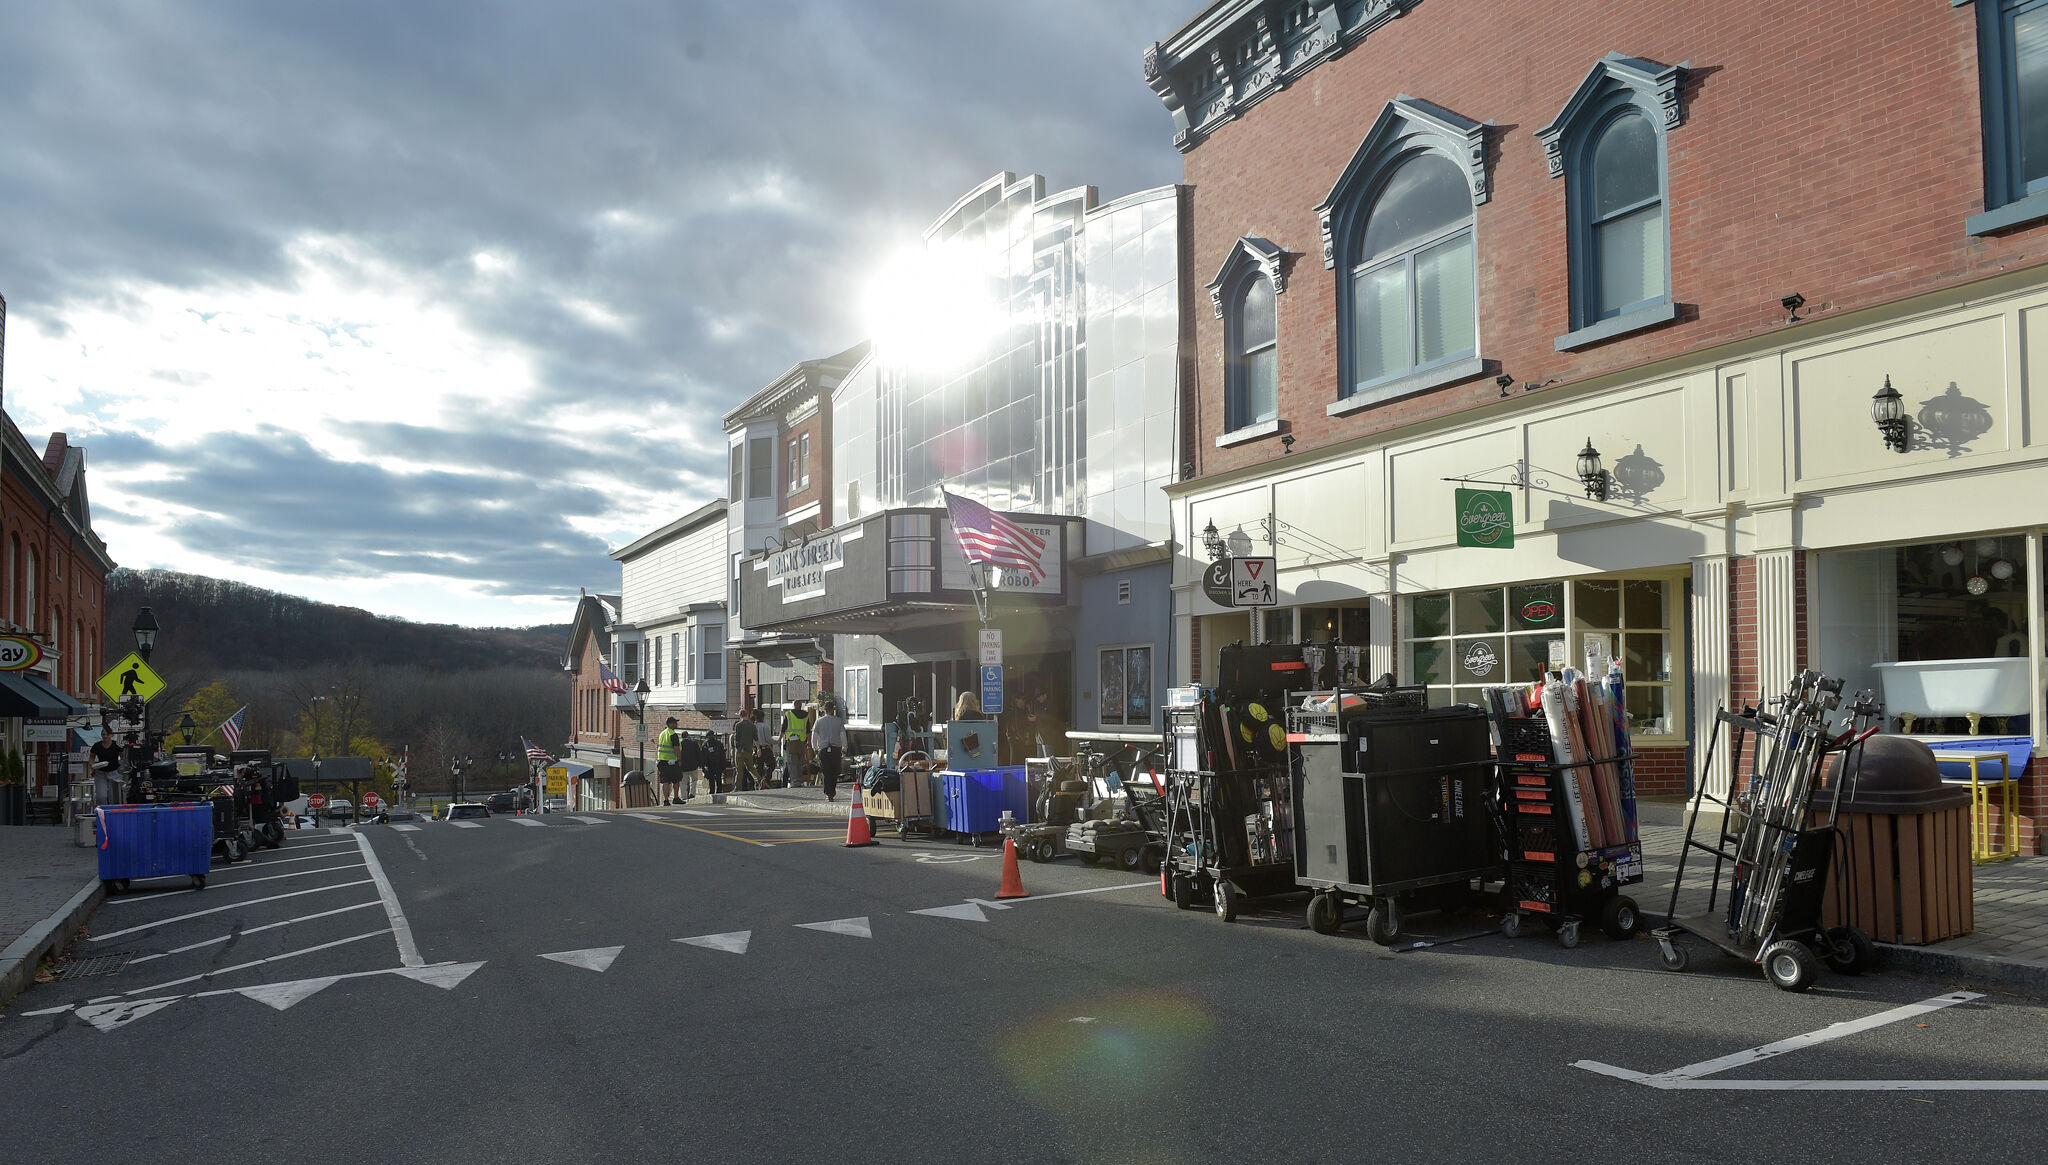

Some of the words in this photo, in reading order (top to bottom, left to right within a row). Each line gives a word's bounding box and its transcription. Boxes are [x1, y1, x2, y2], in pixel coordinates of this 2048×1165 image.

[1461, 510, 1506, 528] Evergreen
[774, 548, 799, 576] BANK
[799, 538, 834, 568] STREET
[786, 570, 822, 590] THEATER
[1521, 604, 1555, 618] OPEN
[981, 641, 1001, 649] PARKING
[1, 646, 24, 662] ay
[1464, 654, 1495, 665] Evergreen
[1554, 690, 1562, 705] LEE
[1564, 742, 1572, 754] LEE
[1454, 779, 1464, 818] CINELEASE
[1573, 790, 1582, 804] LEE
